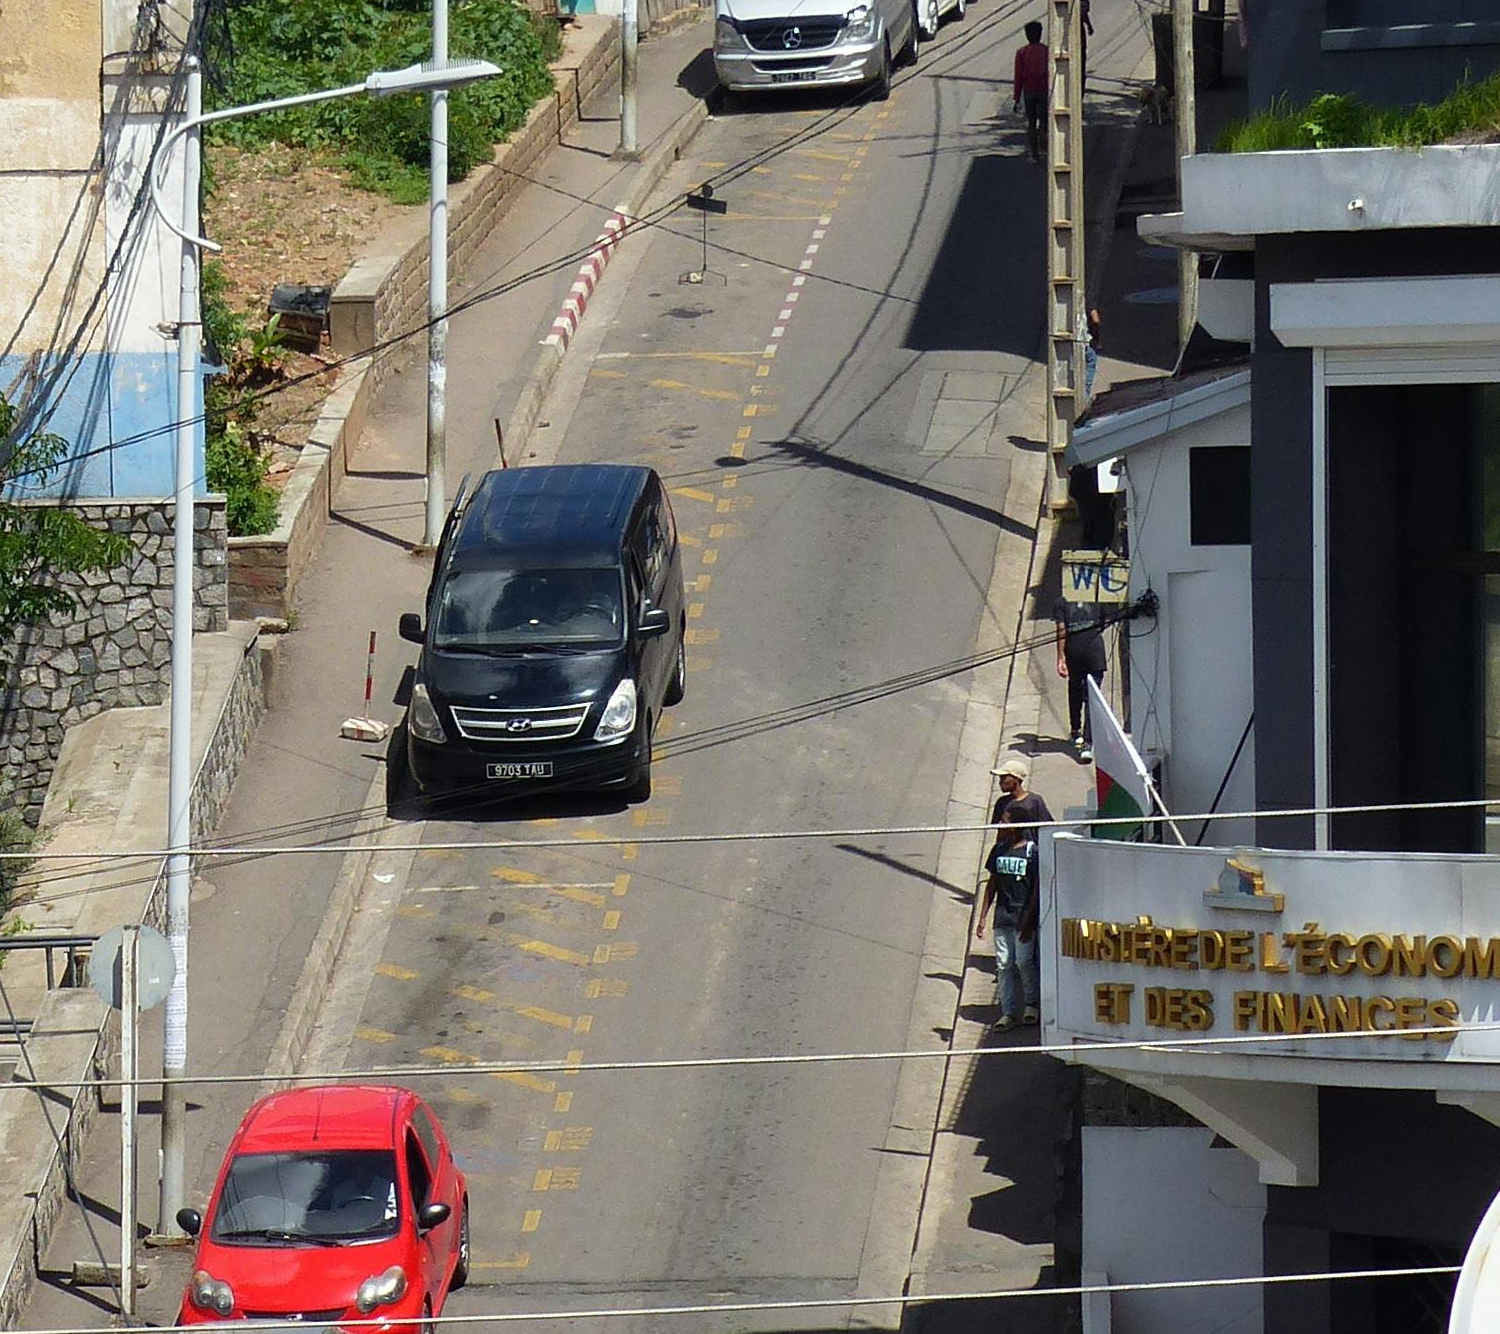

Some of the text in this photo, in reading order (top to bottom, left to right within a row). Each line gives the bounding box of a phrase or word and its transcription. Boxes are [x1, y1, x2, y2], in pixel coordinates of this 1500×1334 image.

[1071, 565, 1128, 592] WC
[495, 765, 521, 776] 9703
[1061, 914, 1500, 979] MINISTÈRE DE L'ÉCONOM
[1094, 982, 1461, 1042] ET DES FINANCES
